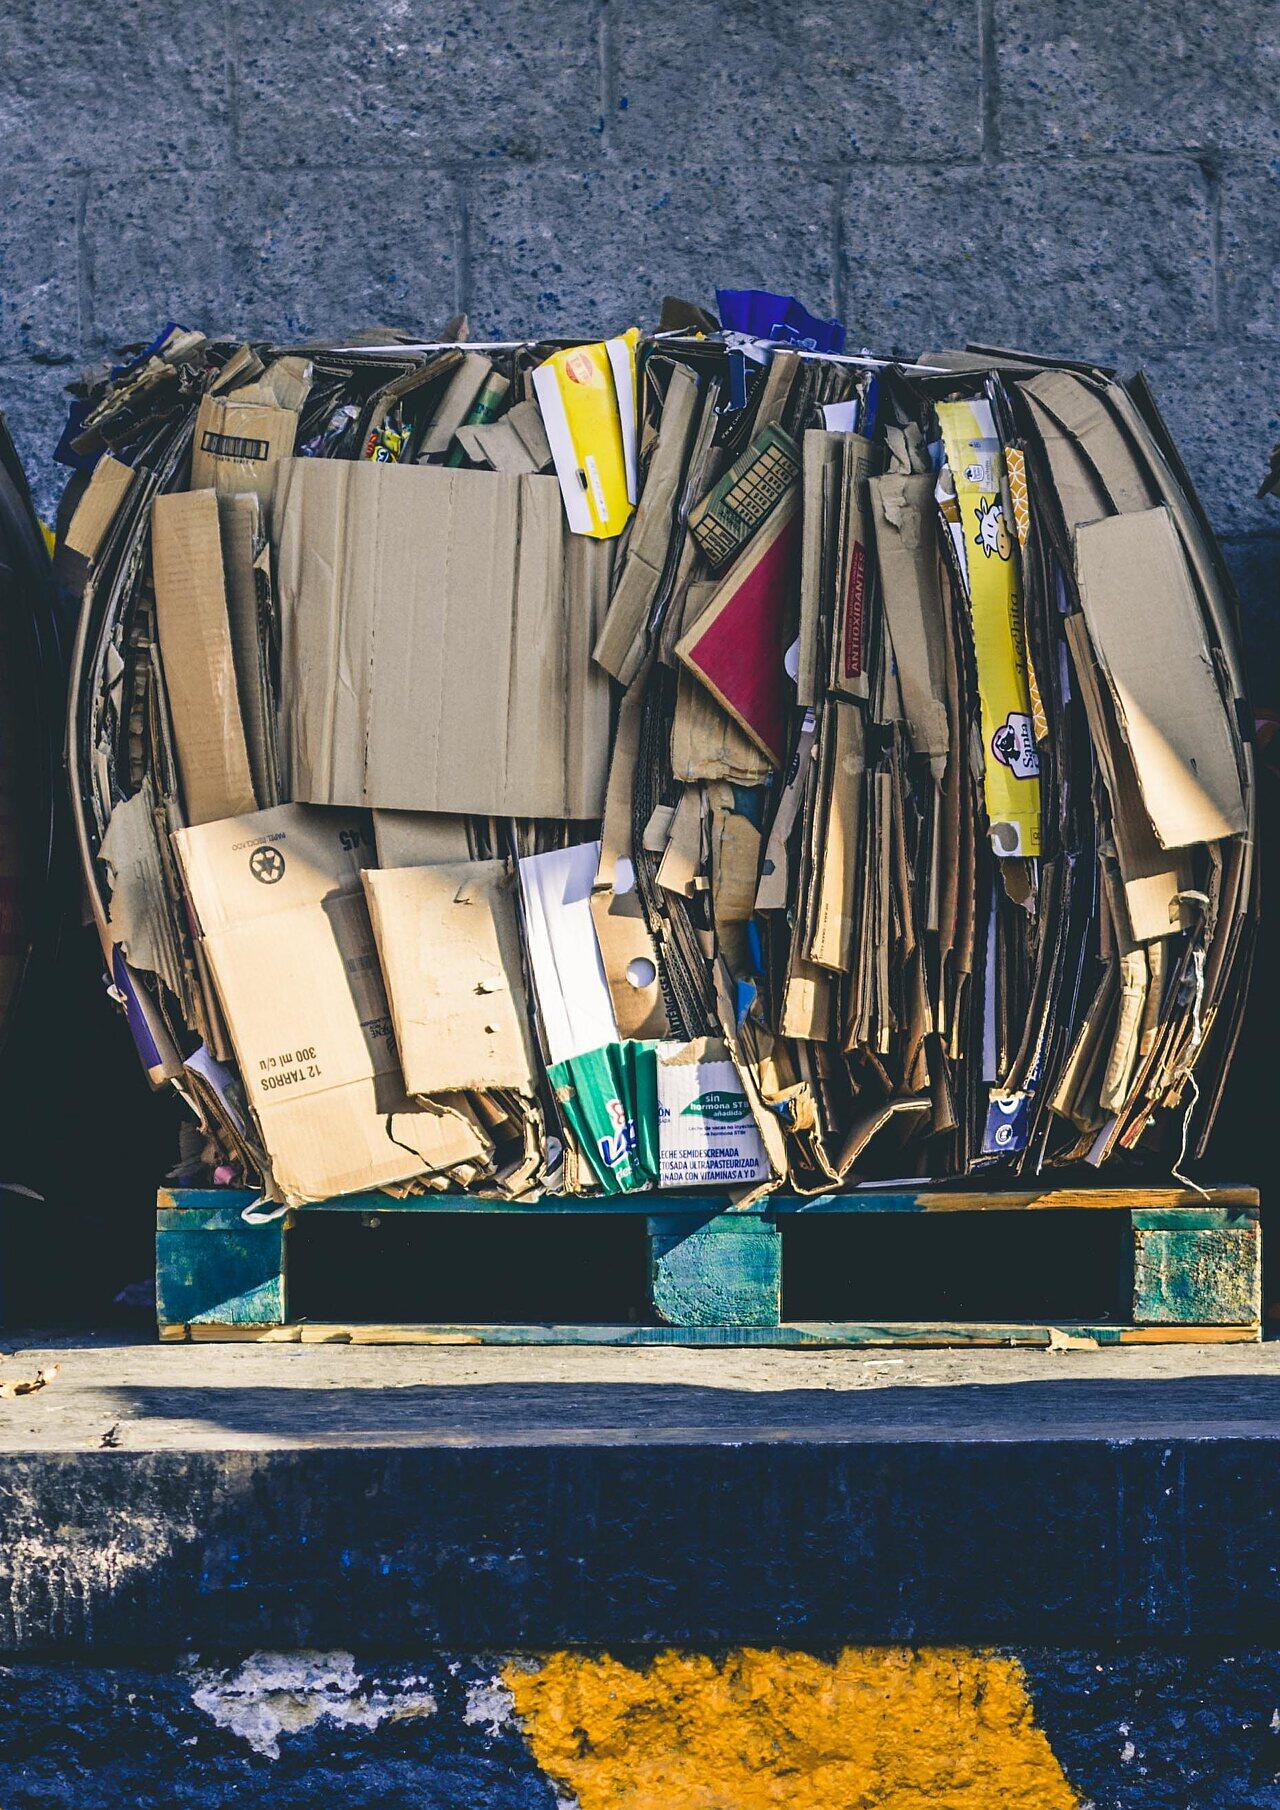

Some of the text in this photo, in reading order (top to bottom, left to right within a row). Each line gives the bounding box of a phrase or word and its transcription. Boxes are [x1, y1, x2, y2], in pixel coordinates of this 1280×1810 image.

[851, 551, 865, 672] ANTIOXIDANTES
[1021, 723, 1035, 769] Santa
[259, 1046, 316, 1071] 300 ml c/u
[260, 1064, 322, 1091] 12 TARROS
[705, 1094, 720, 1102] sin
[690, 1102, 730, 1110] hormona
[660, 1148, 739, 1159] ECHE SEMIDESCREMADA
[660, 1158, 759, 1171] TOSADA ULTRAPASTEURIZADA
[685, 1171, 698, 1180] CON
[701, 1170, 736, 1180] VITAMINAS
[743, 1170, 749, 1178] Y
[750, 1170, 756, 1178] D
